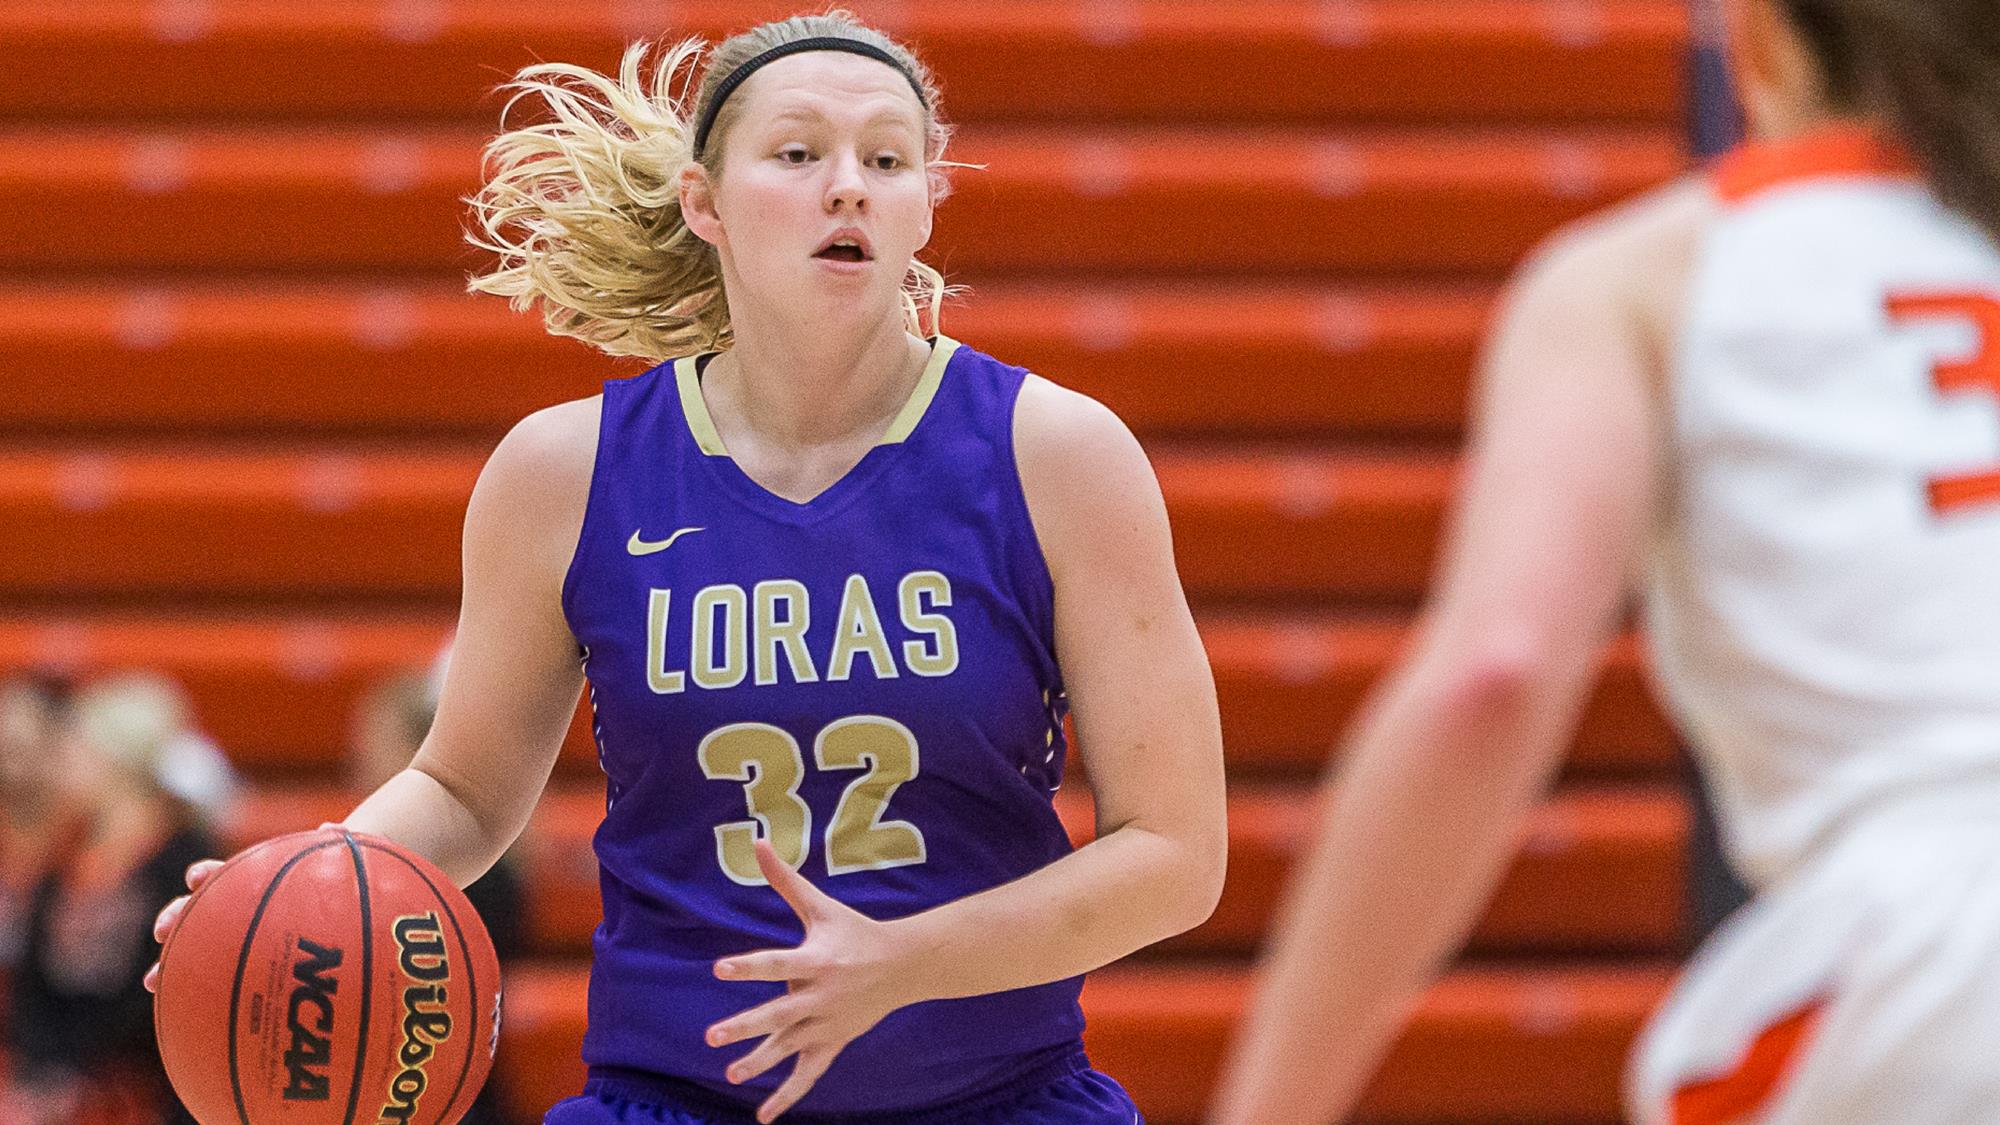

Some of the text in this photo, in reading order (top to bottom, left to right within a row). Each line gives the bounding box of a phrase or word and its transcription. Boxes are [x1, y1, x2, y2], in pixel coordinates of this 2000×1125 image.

[1882, 289, 2000, 517] 3
[647, 570, 960, 694] LORAS
[697, 715, 926, 886] 32
[283, 936, 344, 1101] NCAA
